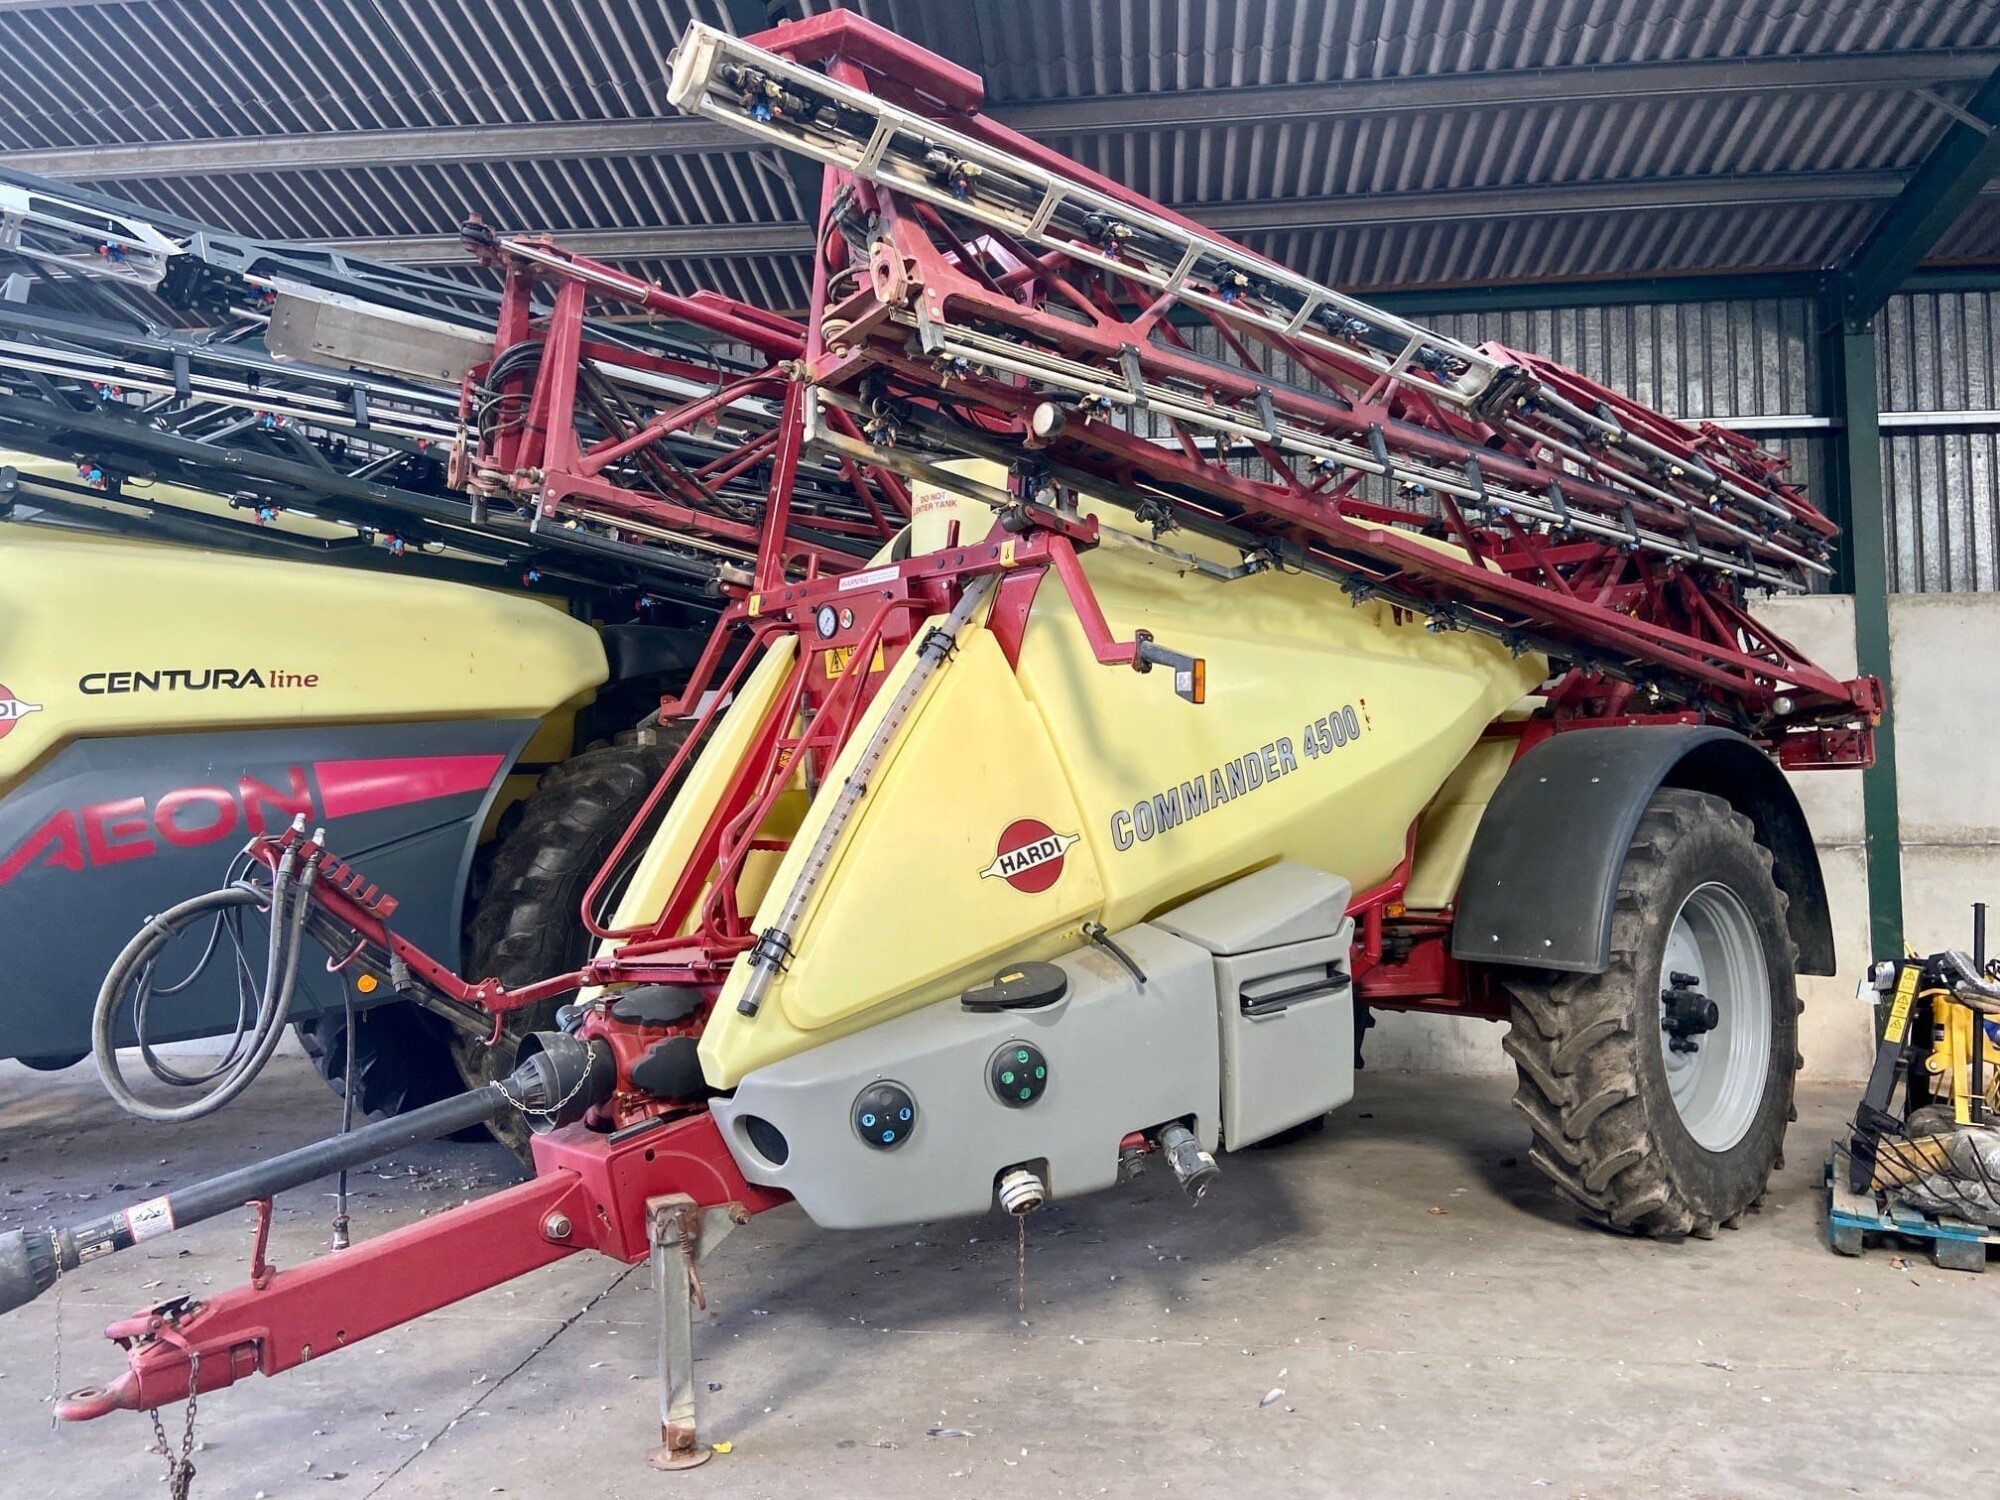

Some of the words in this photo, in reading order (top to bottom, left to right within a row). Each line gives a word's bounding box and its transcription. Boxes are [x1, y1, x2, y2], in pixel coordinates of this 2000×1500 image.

[930, 492, 946, 501] NOT
[935, 499, 958, 509] TANK
[79, 668, 265, 694] CENTURA
[269, 670, 319, 688] line
[901, 704, 908, 712] 14
[1110, 736, 1298, 852] COMMANDER
[1303, 704, 1361, 760] 4500
[0, 766, 315, 887] AEON
[1000, 837, 1062, 875] HARDI
